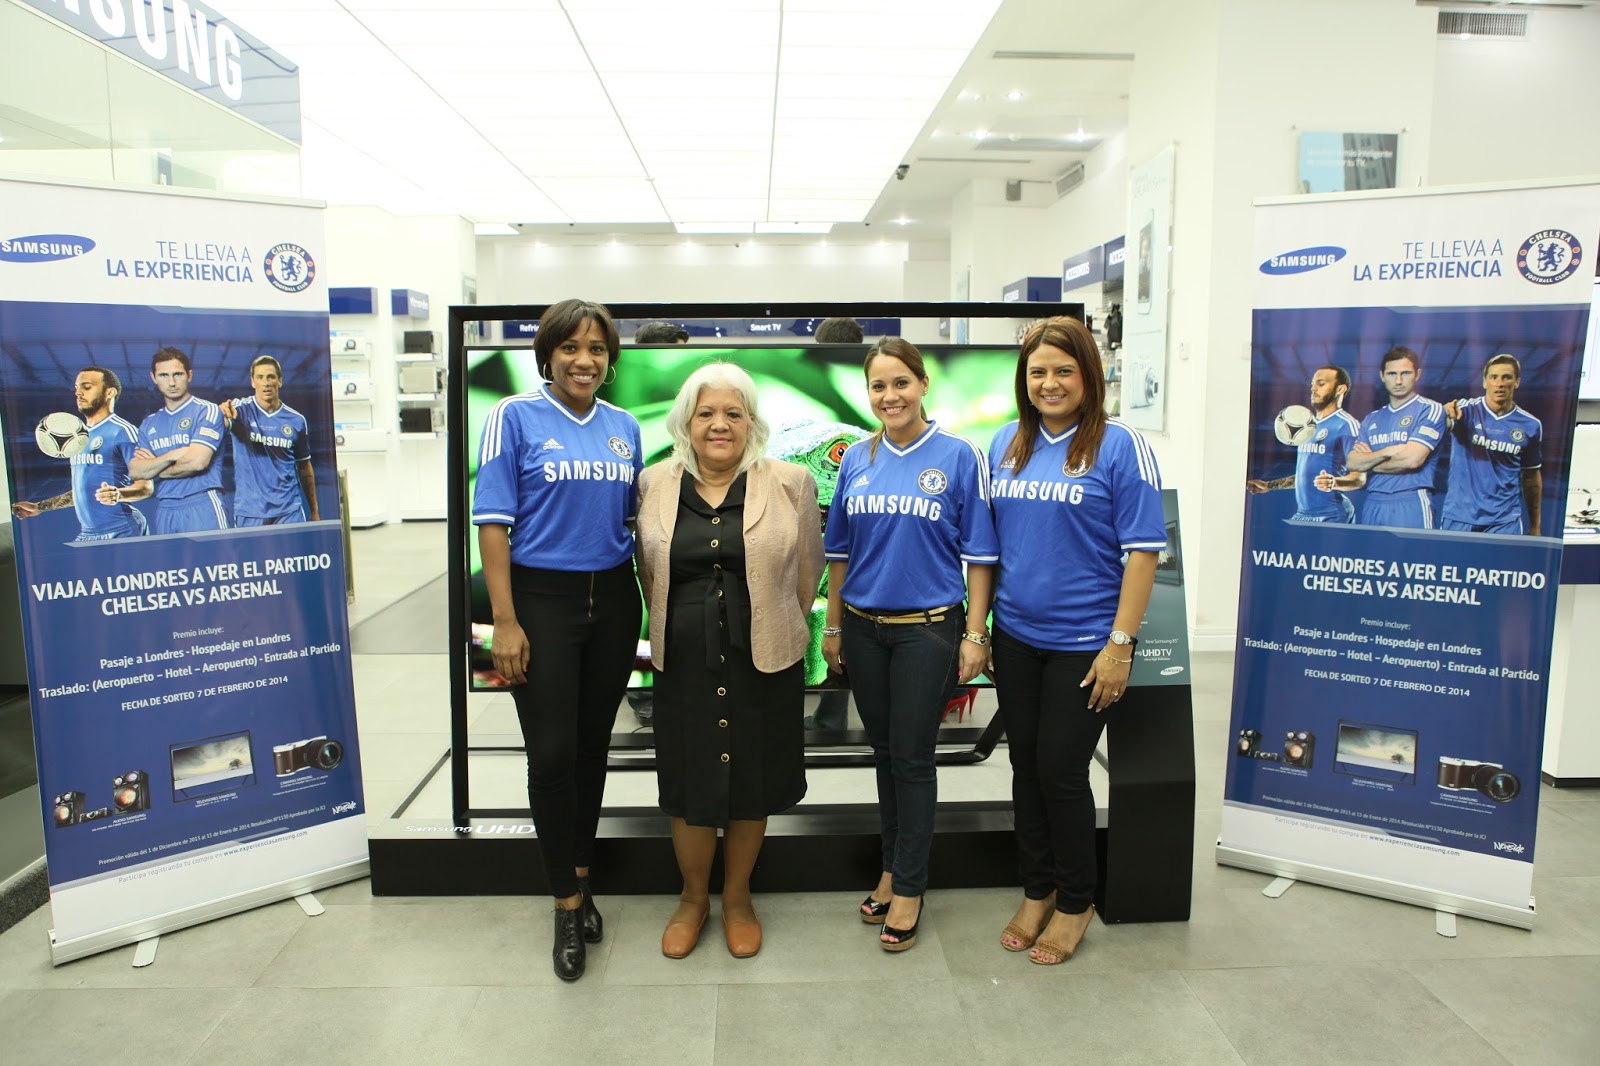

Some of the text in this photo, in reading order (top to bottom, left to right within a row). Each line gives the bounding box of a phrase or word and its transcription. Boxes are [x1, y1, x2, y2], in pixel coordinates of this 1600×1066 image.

[52, 0, 242, 101] SUNG
[1, 240, 84, 256] SAMSUNG
[1402, 238, 1504, 260] TE LLEVA A
[1528, 230, 1571, 244] CHELSEA
[155, 240, 252, 263] TE LLEVA A
[272, 244, 306, 257] CHELSEA
[1270, 254, 1336, 268] SAMSUNG
[106, 258, 254, 282] LA EXPERIENCIA
[1353, 260, 1502, 282] LA EXPERIENCIA
[1525, 270, 1570, 283] FOOTBALL CLUB
[273, 280, 308, 292] FOOTBALL CLUB
[750, 323, 782, 331] Smart TV
[250, 432, 293, 448] SAMSUNG
[1472, 434, 1521, 455] SAMSUNG
[70, 454, 104, 465] MSUNG
[544, 460, 635, 486] SAMSUNG
[990, 478, 1084, 505] SAMSUNG
[847, 494, 942, 522] SAMSUNG
[32, 553, 331, 602] VIAJA A LONDRES A VER EL PARTIDO
[1252, 550, 1546, 590] VIAJA A LONDRES A VER EL PARTIDO
[101, 579, 282, 616] CHELSEA VS ARSENAL
[1303, 574, 1481, 606] CHELSEA VS ARSENAL
[172, 626, 224, 640] Premio incluye:
[1360, 617, 1412, 630] Premio incluye:
[100, 655, 134, 670] Pasaje
[144, 648, 184, 662] Londres
[191, 640, 240, 656] Hospedaje
[242, 640, 254, 648] en
[256, 633, 292, 646] Londres
[1294, 626, 1322, 639] Pasaje
[1332, 630, 1368, 643] Londres
[1375, 634, 1424, 651] Hospedaje
[1427, 643, 1440, 651] en
[1442, 642, 1482, 656] Londres
[39, 642, 341, 698] Traslado: (Aeropuerto Hotel Aeropuerto) Entrada al Partido
[1244, 637, 1540, 681] Traslado: (Aeropuerto Hotel Aeropuerto) Entrada al Partido
[122, 676, 288, 712] FECHA DE SORTEO 7 DE FEBRERO DE 2014
[1304, 668, 1470, 696] FECHA DE SORTEO 7 DE FEBRERO DE 2014
[475, 824, 536, 834] UHD
[1262, 794, 1284, 803] Promoción
[1312, 804, 1333, 812] Diciembre
[1465, 831, 1474, 840] por
[98, 854, 124, 866] Promoción
[159, 840, 182, 851] Diciembre
[220, 828, 232, 836] Enero
[1274, 816, 1298, 827] Participa
[1300, 820, 1330, 832] registrando
[1338, 829, 1360, 839] compra
[1369, 835, 1460, 856] www.experienciasamsung.com
[118, 872, 146, 884] Participa
[148, 863, 183, 877] registrando
[192, 855, 214, 866] compra
[224, 830, 308, 856] www.experienciasamsung.com
